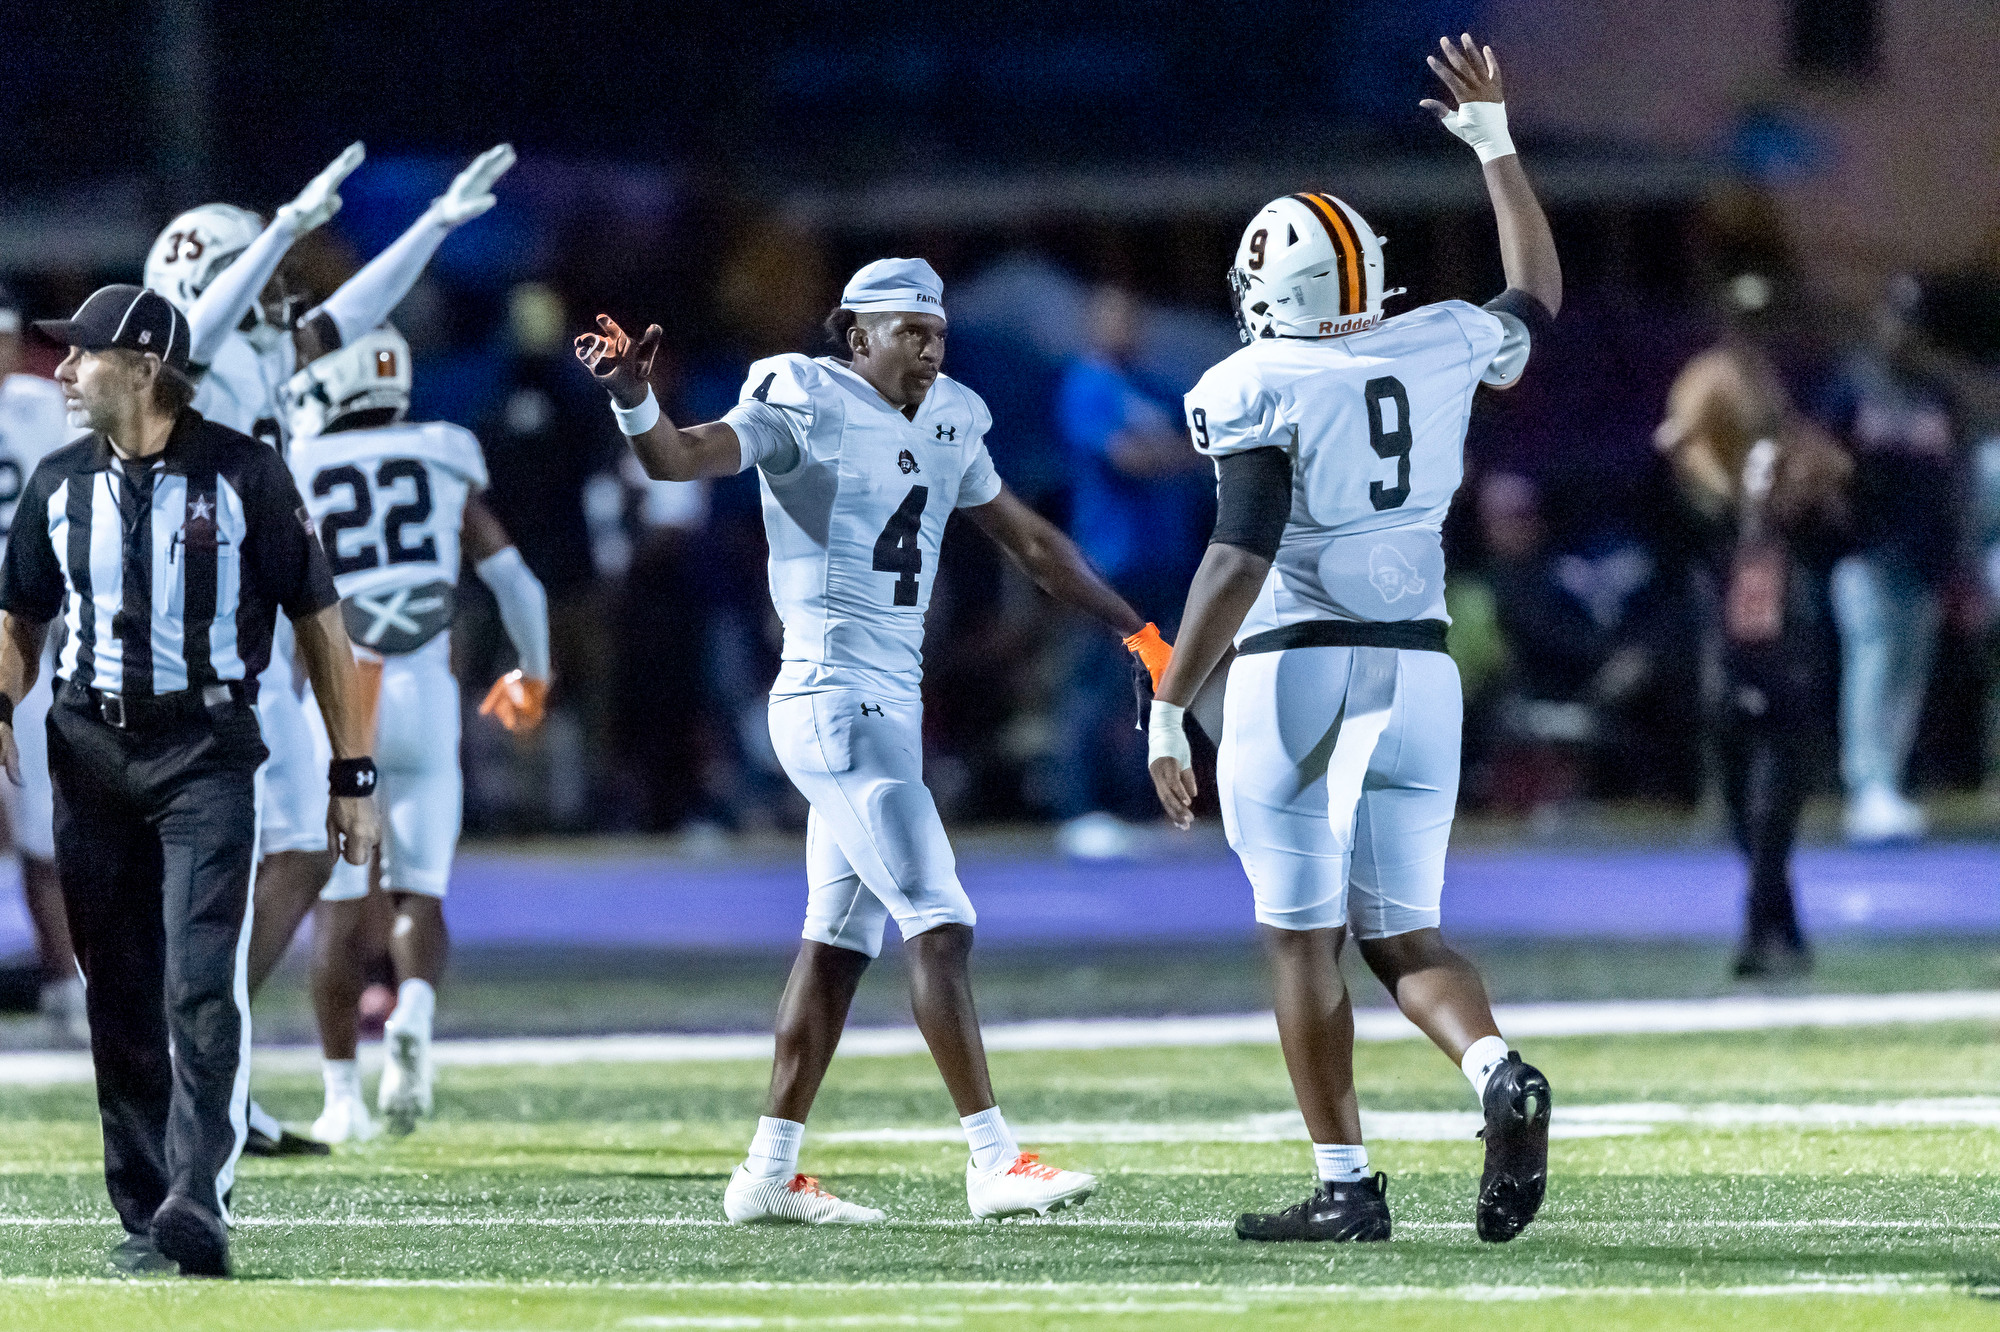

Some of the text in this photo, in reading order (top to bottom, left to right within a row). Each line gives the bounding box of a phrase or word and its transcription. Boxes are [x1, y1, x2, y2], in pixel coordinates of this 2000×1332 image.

[1248, 228, 1268, 271] 9
[1319, 314, 1379, 334] Riddell
[752, 371, 777, 403] 4
[1192, 407, 1210, 450] 9
[1365, 375, 1413, 511] 9
[312, 458, 438, 576] 22
[872, 484, 929, 606] 4
